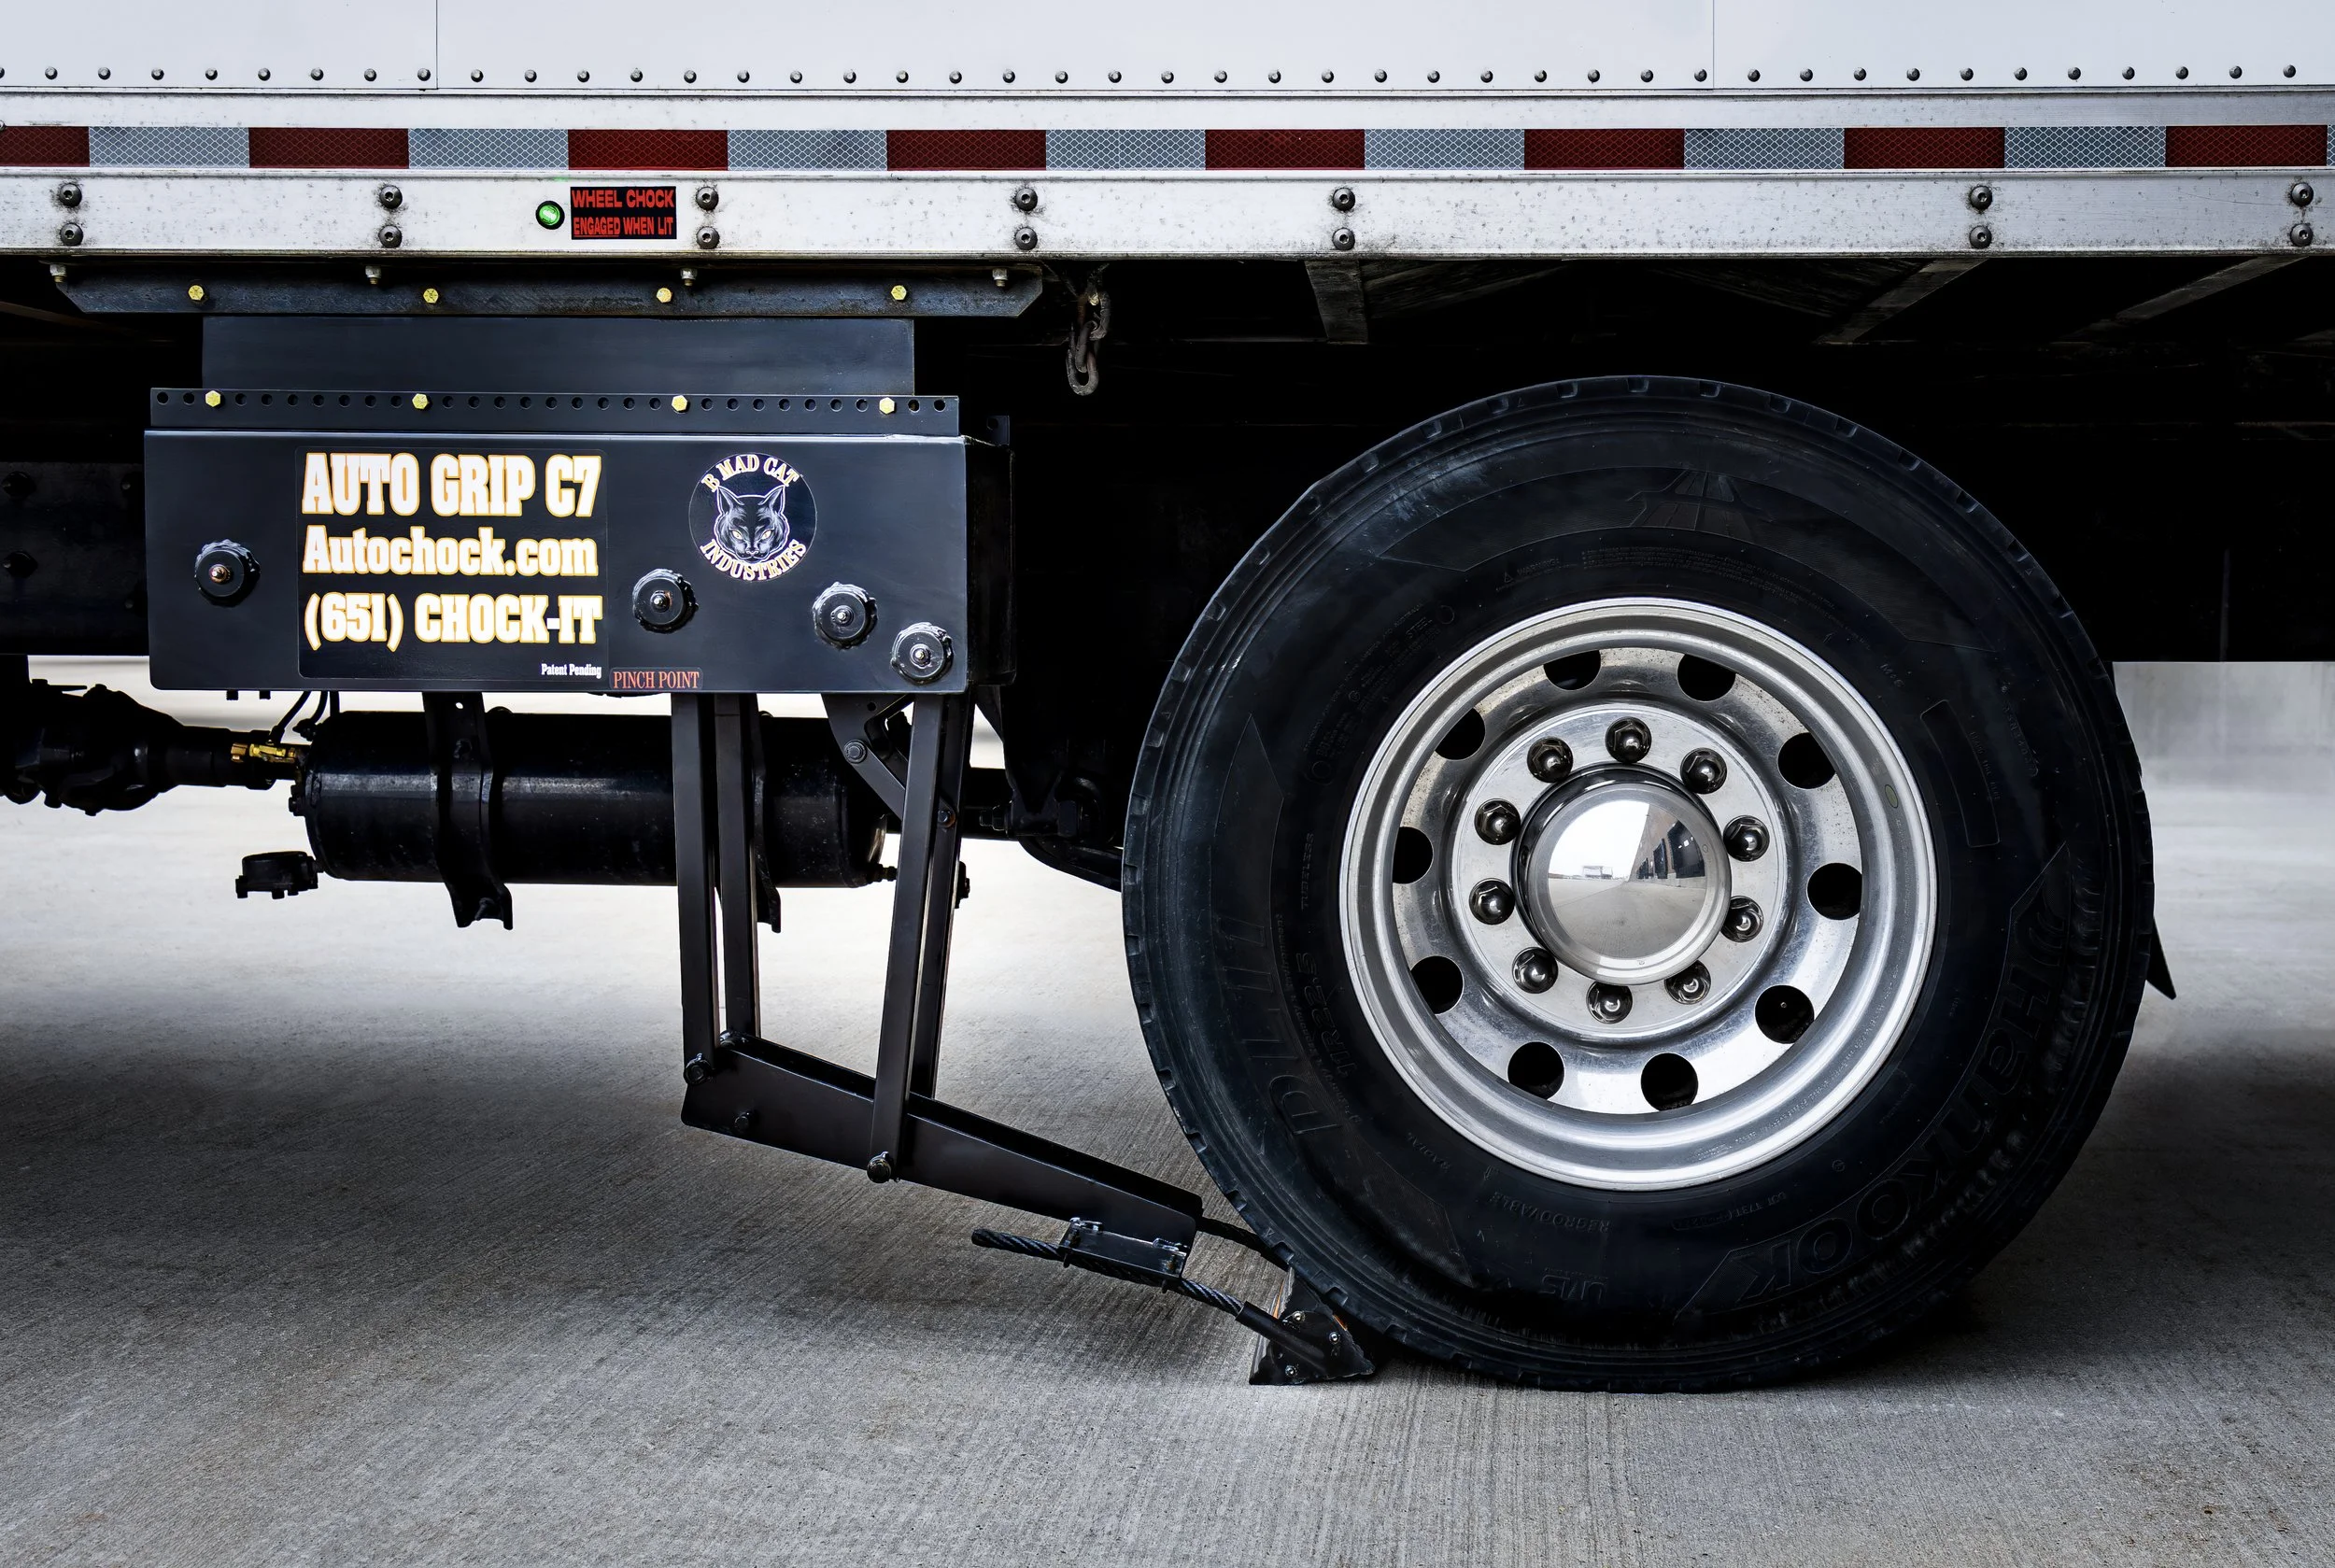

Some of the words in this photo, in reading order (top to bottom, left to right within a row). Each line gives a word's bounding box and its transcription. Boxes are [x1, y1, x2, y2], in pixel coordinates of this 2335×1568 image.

[571, 190, 623, 208] WHEEL
[626, 189, 674, 208] CHOCK
[573, 217, 621, 235] ENGAGED
[623, 217, 655, 235] WHEN
[658, 217, 673, 235] LIT
[302, 452, 420, 516] AUTO
[431, 453, 536, 516] GRIP
[545, 454, 601, 517] C7
[701, 473, 720, 492] B
[715, 454, 759, 481] MAD
[763, 457, 800, 487] CAT
[302, 525, 599, 576] Autochock.com
[700, 539, 807, 580] INDUSTRIES
[304, 592, 404, 652] (651)
[415, 592, 603, 643] CHOCK-IT
[541, 664, 567, 676] Patent
[568, 665, 602, 679] Pending
[613, 671, 657, 689] PINCH
[658, 671, 700, 689] POINT
